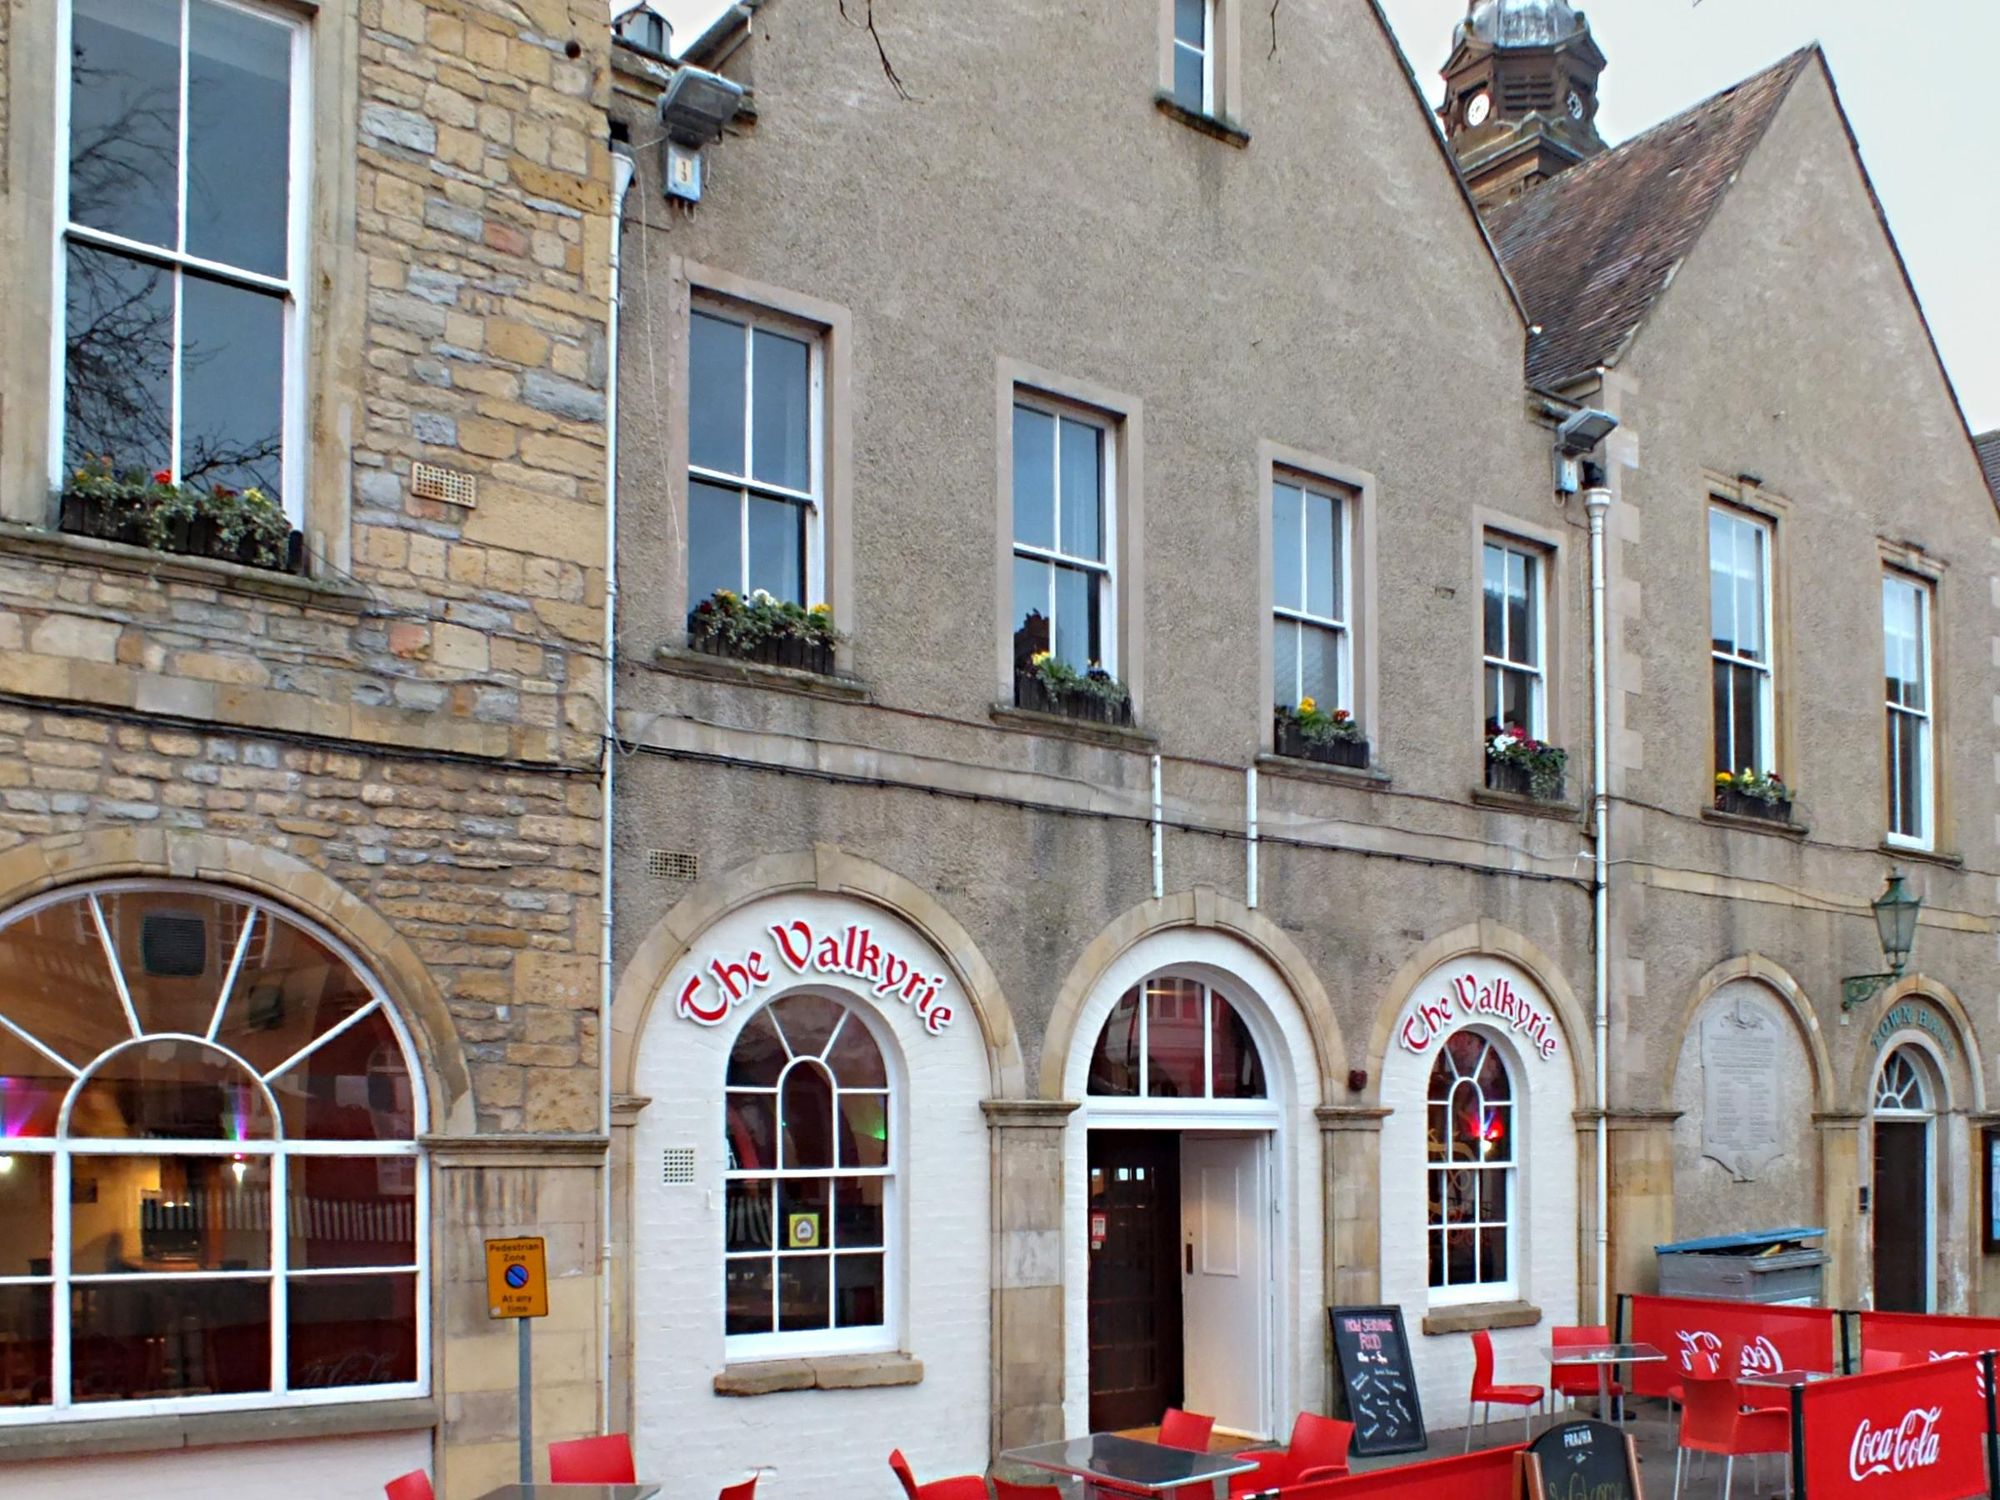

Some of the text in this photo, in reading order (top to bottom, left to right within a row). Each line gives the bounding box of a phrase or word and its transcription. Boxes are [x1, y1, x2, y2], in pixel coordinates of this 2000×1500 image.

[680, 920, 952, 1030] The Valkyrie
[1402, 973, 1557, 1057] The Valkyrie
[1871, 1004, 1913, 1050] TOWN
[489, 1243, 540, 1252] Pedestrian
[504, 1253, 526, 1262] Zone
[502, 1295, 532, 1303] At any
